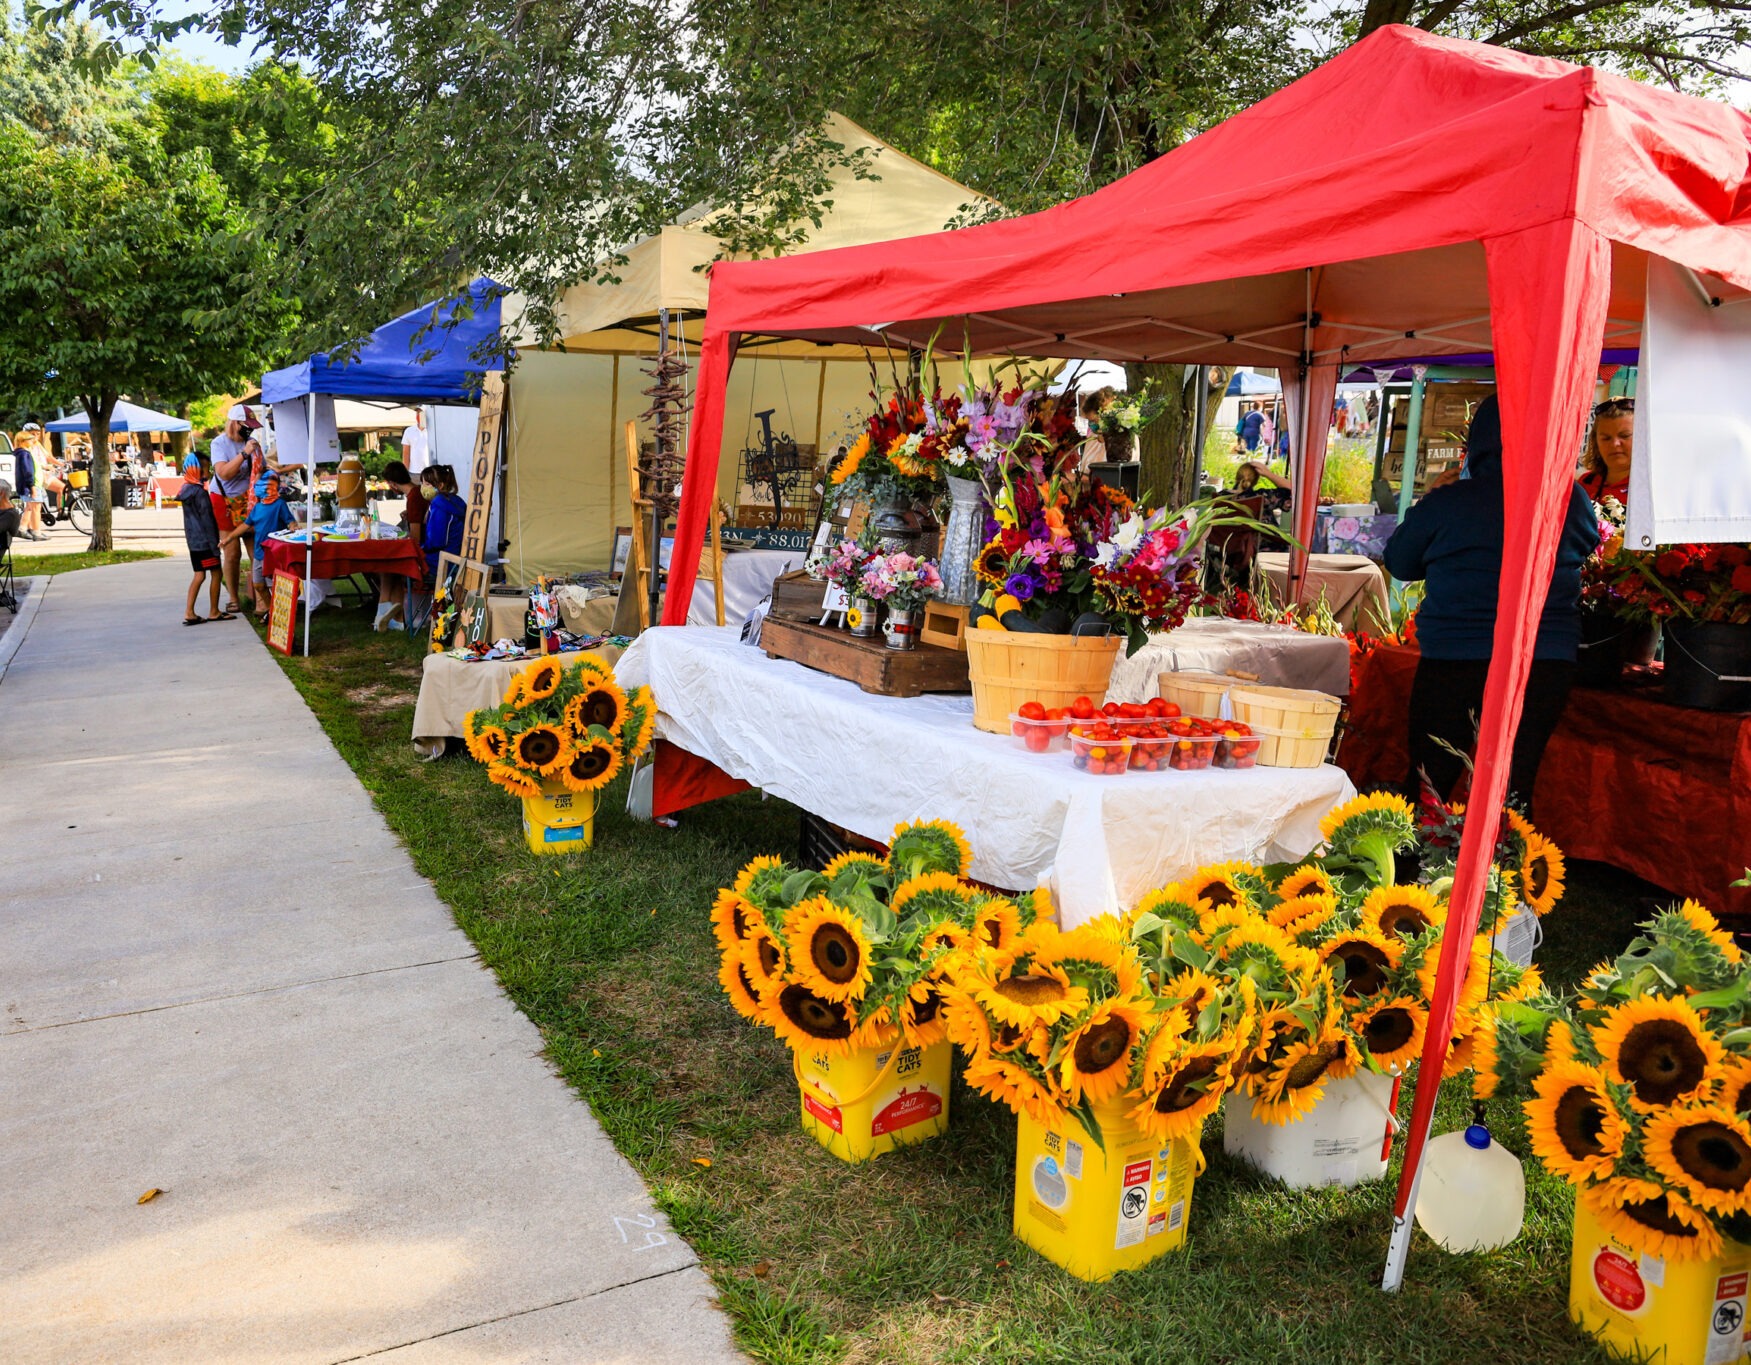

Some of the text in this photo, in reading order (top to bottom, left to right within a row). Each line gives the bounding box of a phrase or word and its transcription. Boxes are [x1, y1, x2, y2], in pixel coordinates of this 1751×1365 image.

[1427, 447, 1454, 459] FARM
[465, 431, 491, 561] PORCH
[471, 607, 485, 642] HO
[898, 1051, 921, 1065] TIDY
[897, 1060, 922, 1074] CATS
[900, 1097, 917, 1110] 24/7
[1044, 1139, 1061, 1152] CATS
[1045, 1133, 1061, 1145] TIDY
